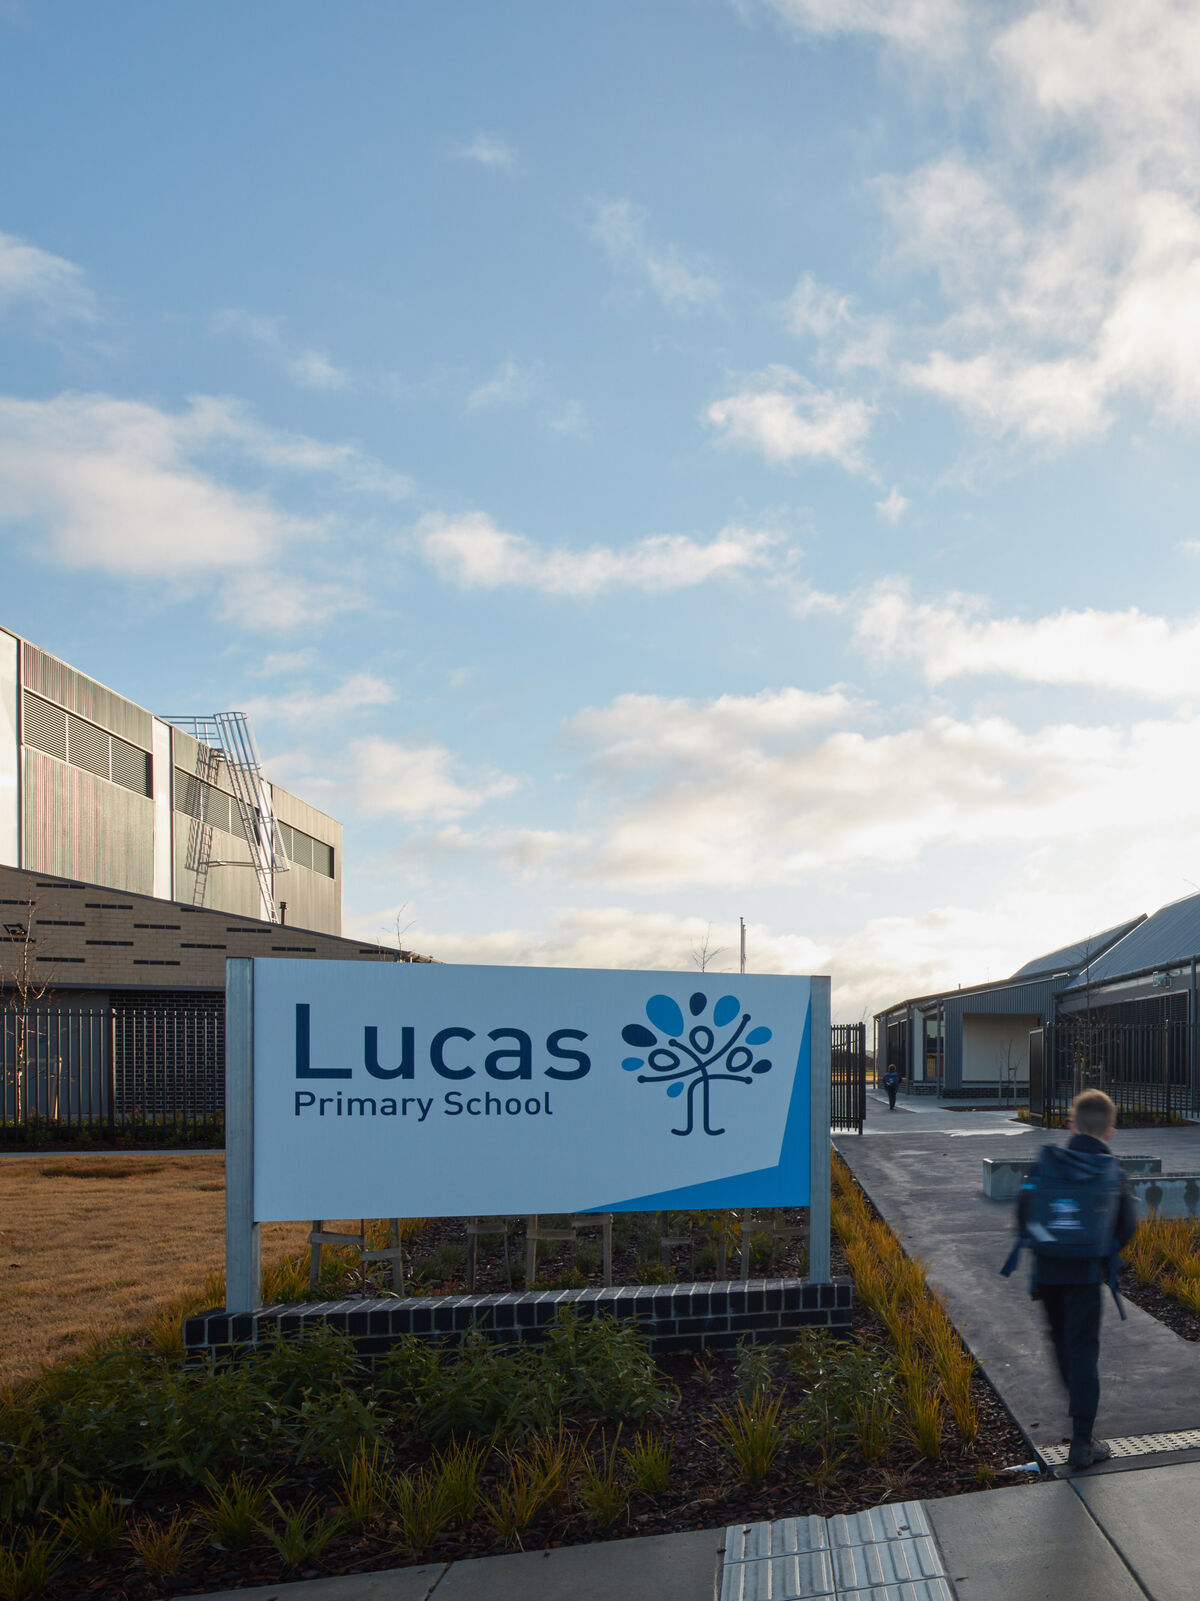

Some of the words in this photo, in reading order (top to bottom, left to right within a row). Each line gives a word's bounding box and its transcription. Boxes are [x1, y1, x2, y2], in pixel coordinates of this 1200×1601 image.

[294, 1003, 591, 1081] Lucas
[294, 1091, 434, 1123] Primary
[443, 1091, 554, 1117] School
